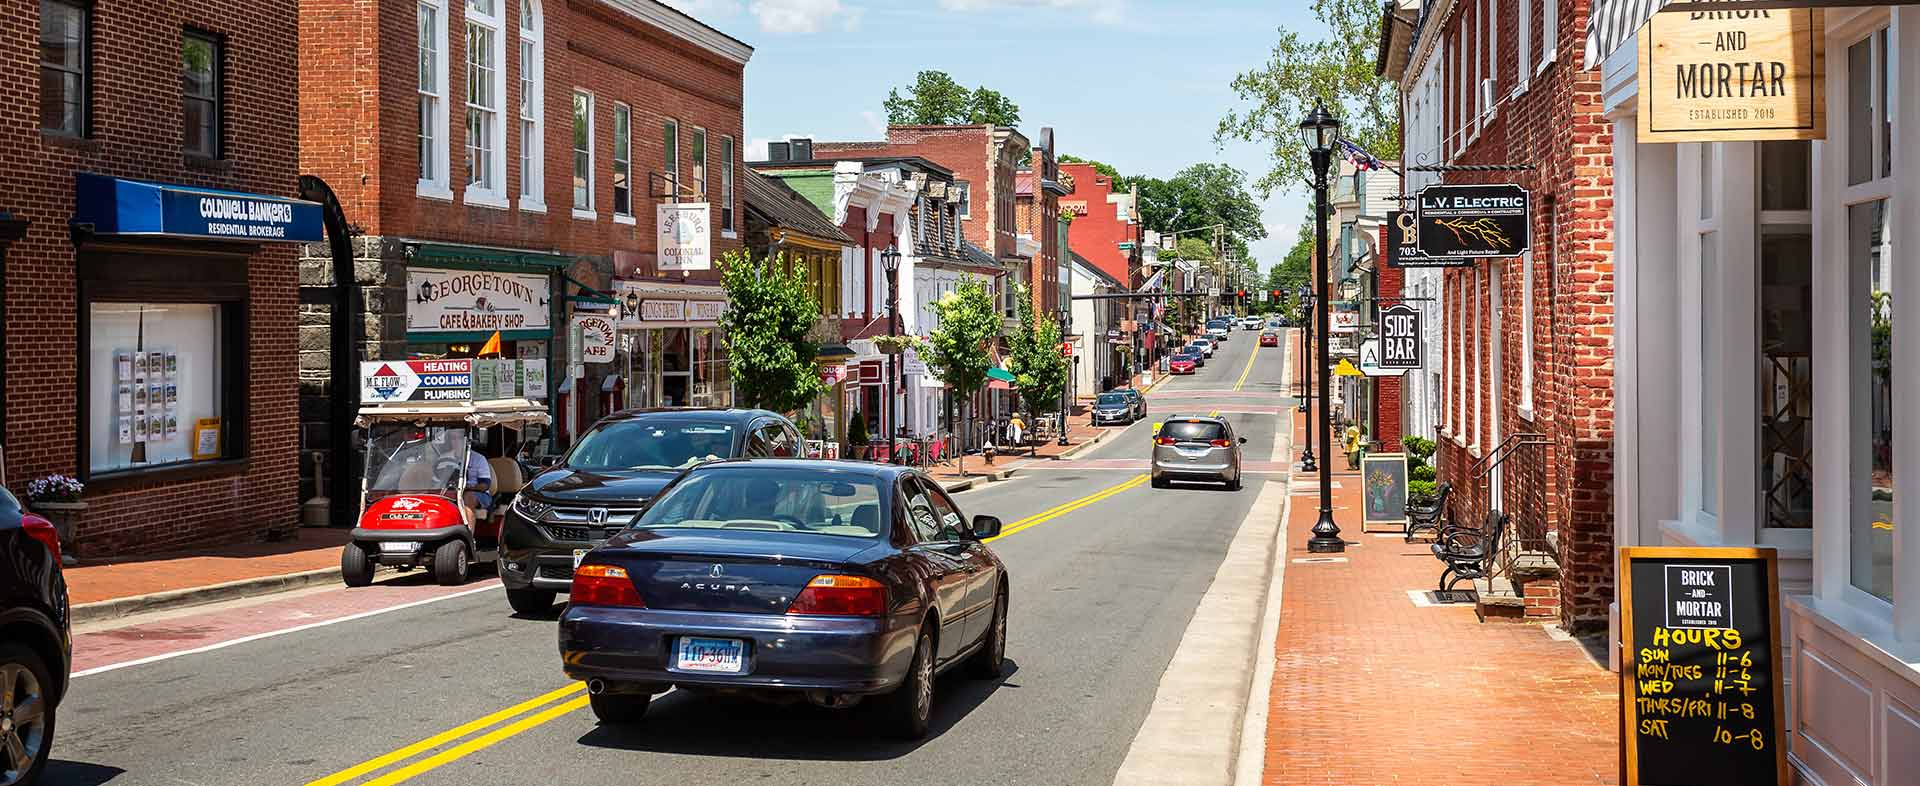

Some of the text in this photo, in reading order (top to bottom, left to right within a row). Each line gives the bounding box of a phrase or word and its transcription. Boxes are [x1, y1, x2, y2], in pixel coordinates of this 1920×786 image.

[1676, 61, 1786, 99] MORTAR
[1689, 108, 1775, 120] ESTABLISHED 2019
[1422, 196, 1524, 208] L.V. ELECTRIC
[208, 223, 285, 238] RESIDENTIAL BROKERAGE
[664, 248, 704, 257] COLONIAL
[675, 256, 694, 265] INN
[504, 314, 525, 328] SHOP
[1384, 315, 1415, 337] SIDE
[584, 346, 607, 356] AFE
[1385, 338, 1416, 360] BAR
[423, 362, 468, 372] HEATING
[423, 375, 469, 386] COOLING
[424, 390, 471, 400] PLUMBING
[1681, 570, 1715, 586] BRICK
[681, 582, 751, 592] ACURA
[1676, 601, 1722, 617] MORTAR
[1653, 626, 1742, 650] HOURS
[1641, 648, 1669, 663] SUN
[1638, 663, 1702, 680] MON/TUES
[1640, 680, 1674, 696] WED
[1640, 718, 1669, 740] SAT
